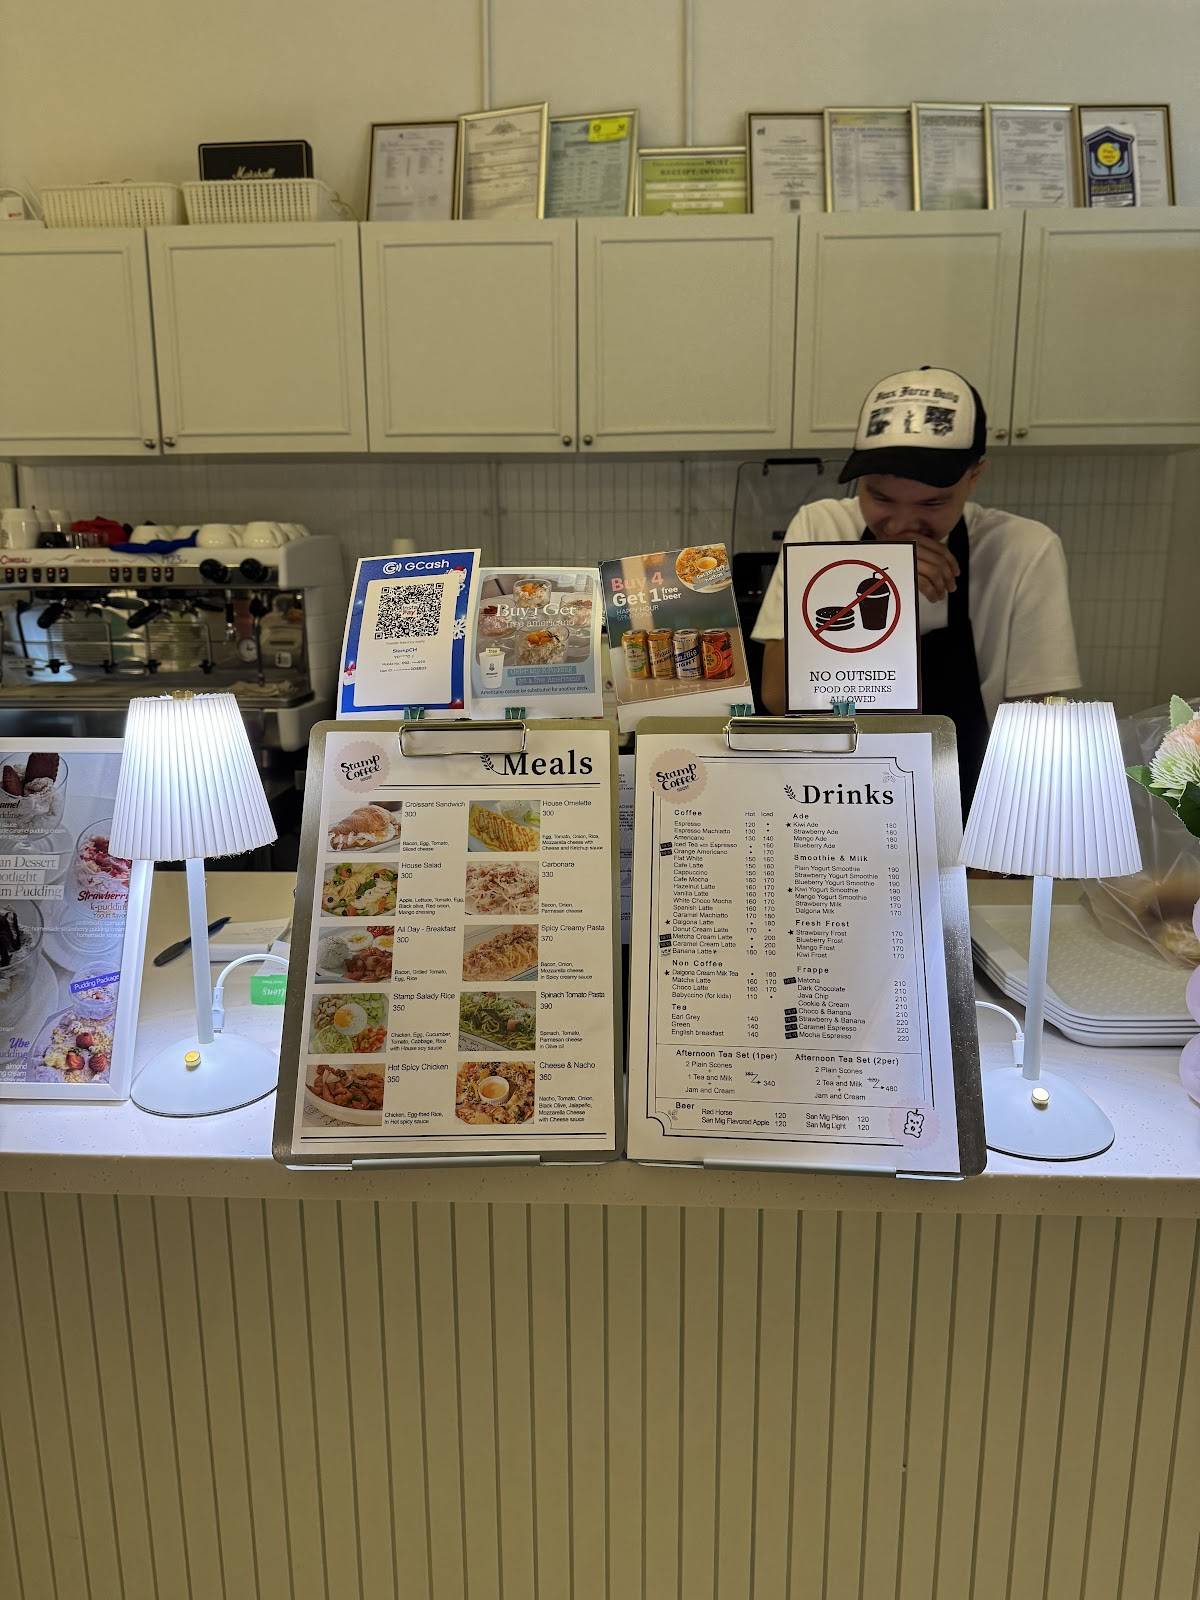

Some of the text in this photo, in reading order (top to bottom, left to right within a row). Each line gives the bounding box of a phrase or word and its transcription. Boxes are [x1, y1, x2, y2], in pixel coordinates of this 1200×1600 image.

[405, 560, 450, 571] GCash
[611, 571, 664, 593] Buy 4
[612, 591, 647, 608] Get
[649, 587, 662, 603] 1
[662, 592, 682, 601] beer
[496, 604, 530, 620] Buy
[543, 603, 577, 617] Get
[639, 604, 660, 613] HOUR
[809, 670, 896, 682] NO OUTSIDE
[814, 685, 892, 694] FOOD OR DRINKS
[829, 695, 876, 704] ALLOWED
[340, 754, 380, 773] Stamp
[502, 749, 593, 776] Meals
[345, 764, 382, 781] Coffee
[655, 762, 697, 783] Stamp
[661, 773, 699, 791] Coffee
[802, 783, 894, 805] Drinks
[674, 809, 703, 817] Coffee
[673, 848, 696, 856] Orange
[14, 856, 57, 868] Dessert
[423, 861, 442, 869] Salad
[827, 873, 848, 881] Yogurt
[14, 885, 62, 898] Pudding
[407, 925, 421, 934] Day
[541, 924, 559, 932] Spicy
[559, 924, 586, 932] Creamy
[396, 936, 410, 944] 300
[796, 944, 818, 952] Mango
[672, 959, 689, 967] Non
[797, 966, 829, 975] Frappe
[74, 973, 120, 991] Pudding Package
[393, 992, 456, 1001] Stamp Salady Rice
[540, 991, 565, 999] Spinach
[392, 1004, 406, 1012] 350
[540, 1002, 553, 1010] 390
[671, 1003, 687, 1011] Tea
[685, 1014, 701, 1022] Grey
[9, 1037, 31, 1049] Ube
[675, 1049, 778, 1061] Afternoon Tea Set (1per)
[794, 1053, 900, 1066] Afternoon Tea Set (2per)
[5, 1062, 28, 1070] almond
[400, 1063, 420, 1072] Spicy
[421, 1063, 449, 1071] Chicken
[539, 1061, 596, 1069] Cheese & Nacho
[7, 1070, 27, 1078] cream
[387, 1075, 400, 1083] 350
[675, 1101, 695, 1109] Beer
[806, 1120, 818, 1128] San
[819, 1121, 831, 1130] Mig
[831, 1122, 846, 1131] Light
